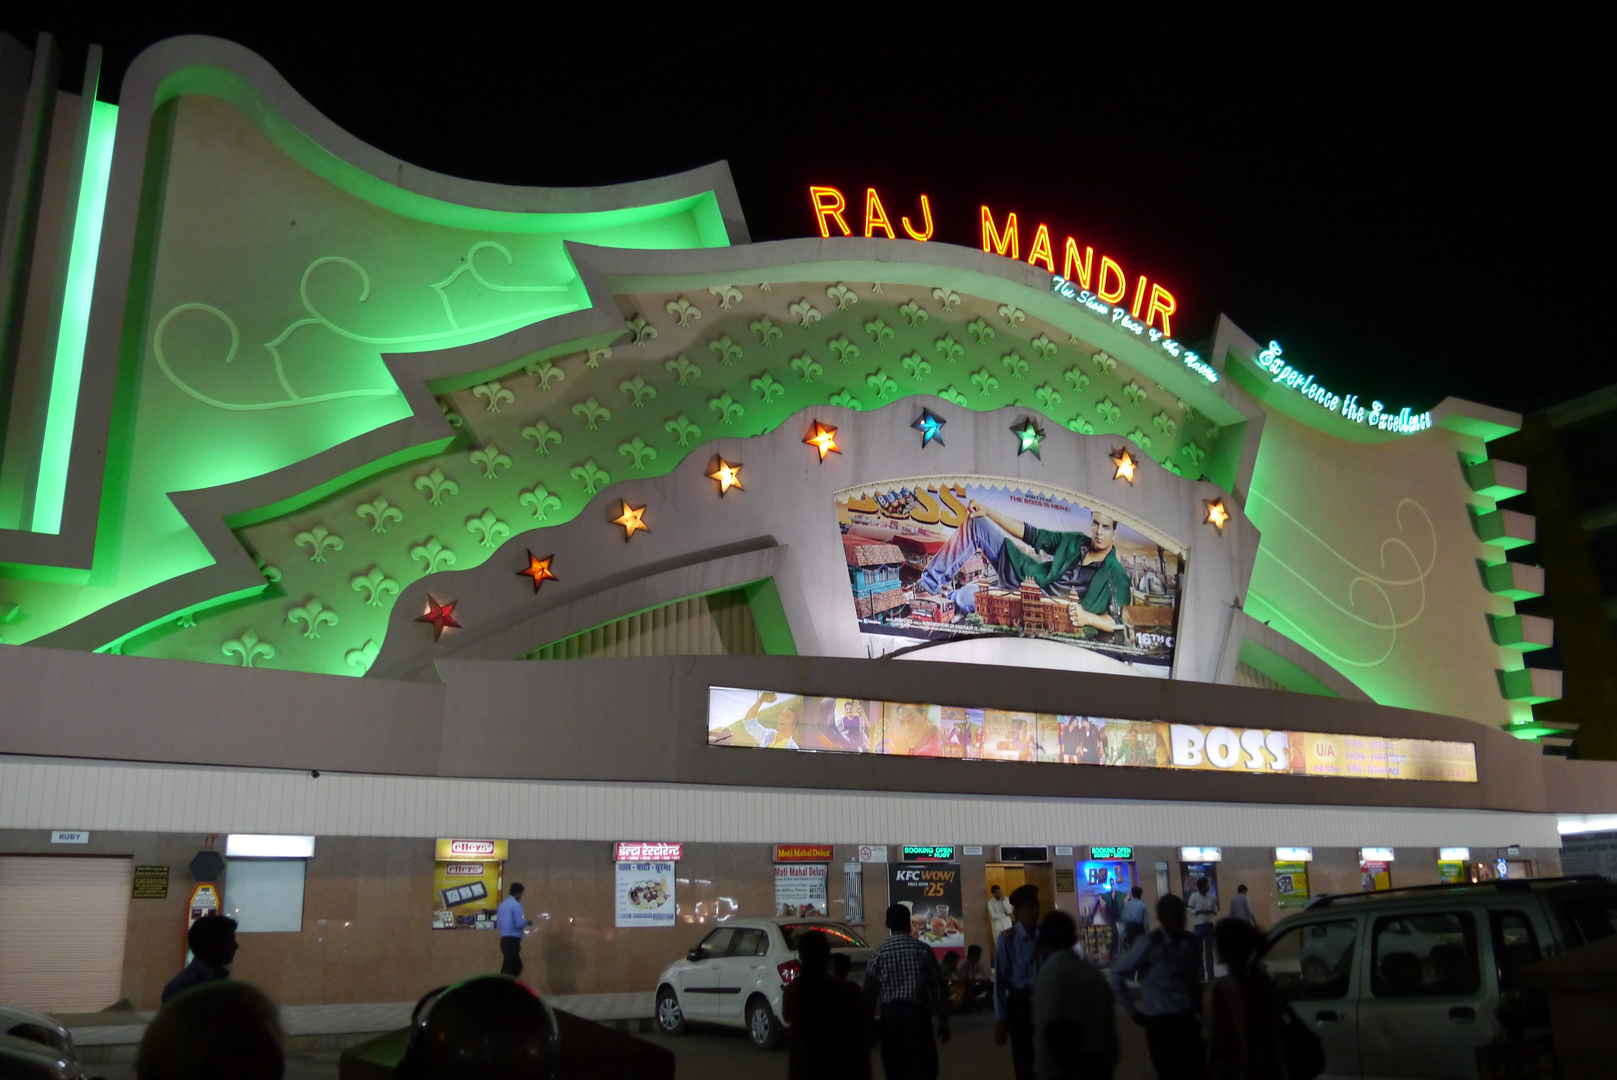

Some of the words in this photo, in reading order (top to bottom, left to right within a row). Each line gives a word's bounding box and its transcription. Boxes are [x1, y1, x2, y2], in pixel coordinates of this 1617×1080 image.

[809, 184, 934, 242] RAJ
[981, 204, 1178, 338] MANDIR
[1051, 275, 1076, 299] The
[1076, 287, 1110, 315] Show
[1112, 307, 1143, 336] Place
[1148, 328, 1162, 342] of
[1162, 339, 1180, 357] the
[1341, 393, 1366, 424] the
[1367, 400, 1434, 434] Excellence
[1009, 495, 1023, 503] THE
[1024, 498, 1043, 507] BOSS
[1051, 503, 1072, 513] HERE!
[1135, 631, 1165, 647] 16TH
[1167, 723, 1290, 771] BOSS
[1316, 743, 1335, 758] U/A
[58, 832, 81, 841] RUBY
[778, 848, 793, 857] Moti
[793, 848, 812, 857] Mahal
[812, 848, 831, 857] Delux
[904, 846, 934, 854] BOOKING
[935, 846, 953, 854] OPEN
[1091, 846, 1116, 854] BOOKING
[1116, 846, 1132, 854] OPEN
[775, 867, 788, 877] Moti
[790, 867, 808, 877] Mahal
[809, 867, 825, 876] Delux
[896, 870, 921, 881] KFC
[921, 870, 956, 883] WOW!
